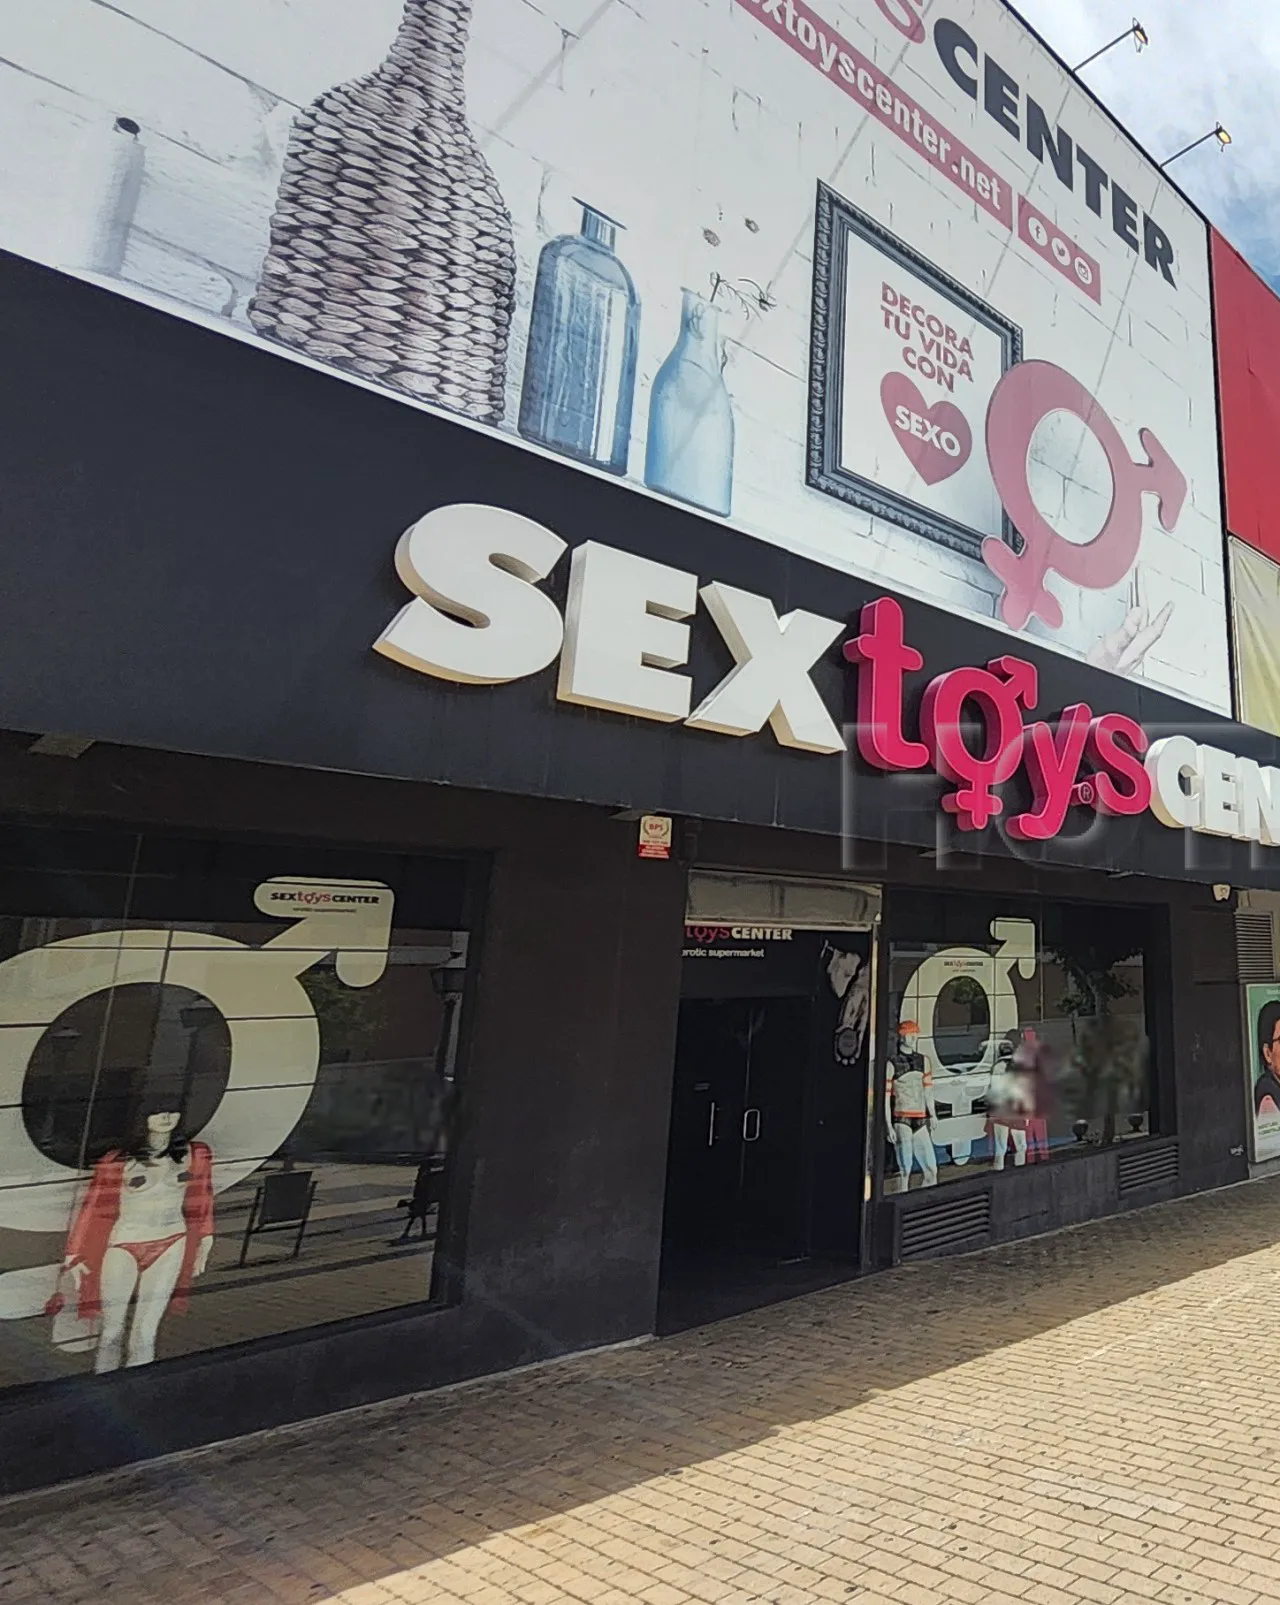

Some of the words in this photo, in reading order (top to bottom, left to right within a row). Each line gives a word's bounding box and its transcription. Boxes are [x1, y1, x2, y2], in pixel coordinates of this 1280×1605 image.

[752, 0, 1001, 210] xtoyscenter.net
[881, 305, 911, 340] TU
[918, 329, 974, 383] VIDA
[882, 281, 974, 360] DECORA
[902, 346, 954, 393] CON
[895, 405, 961, 457] SEXO
[708, 948, 765, 959] supermarket
